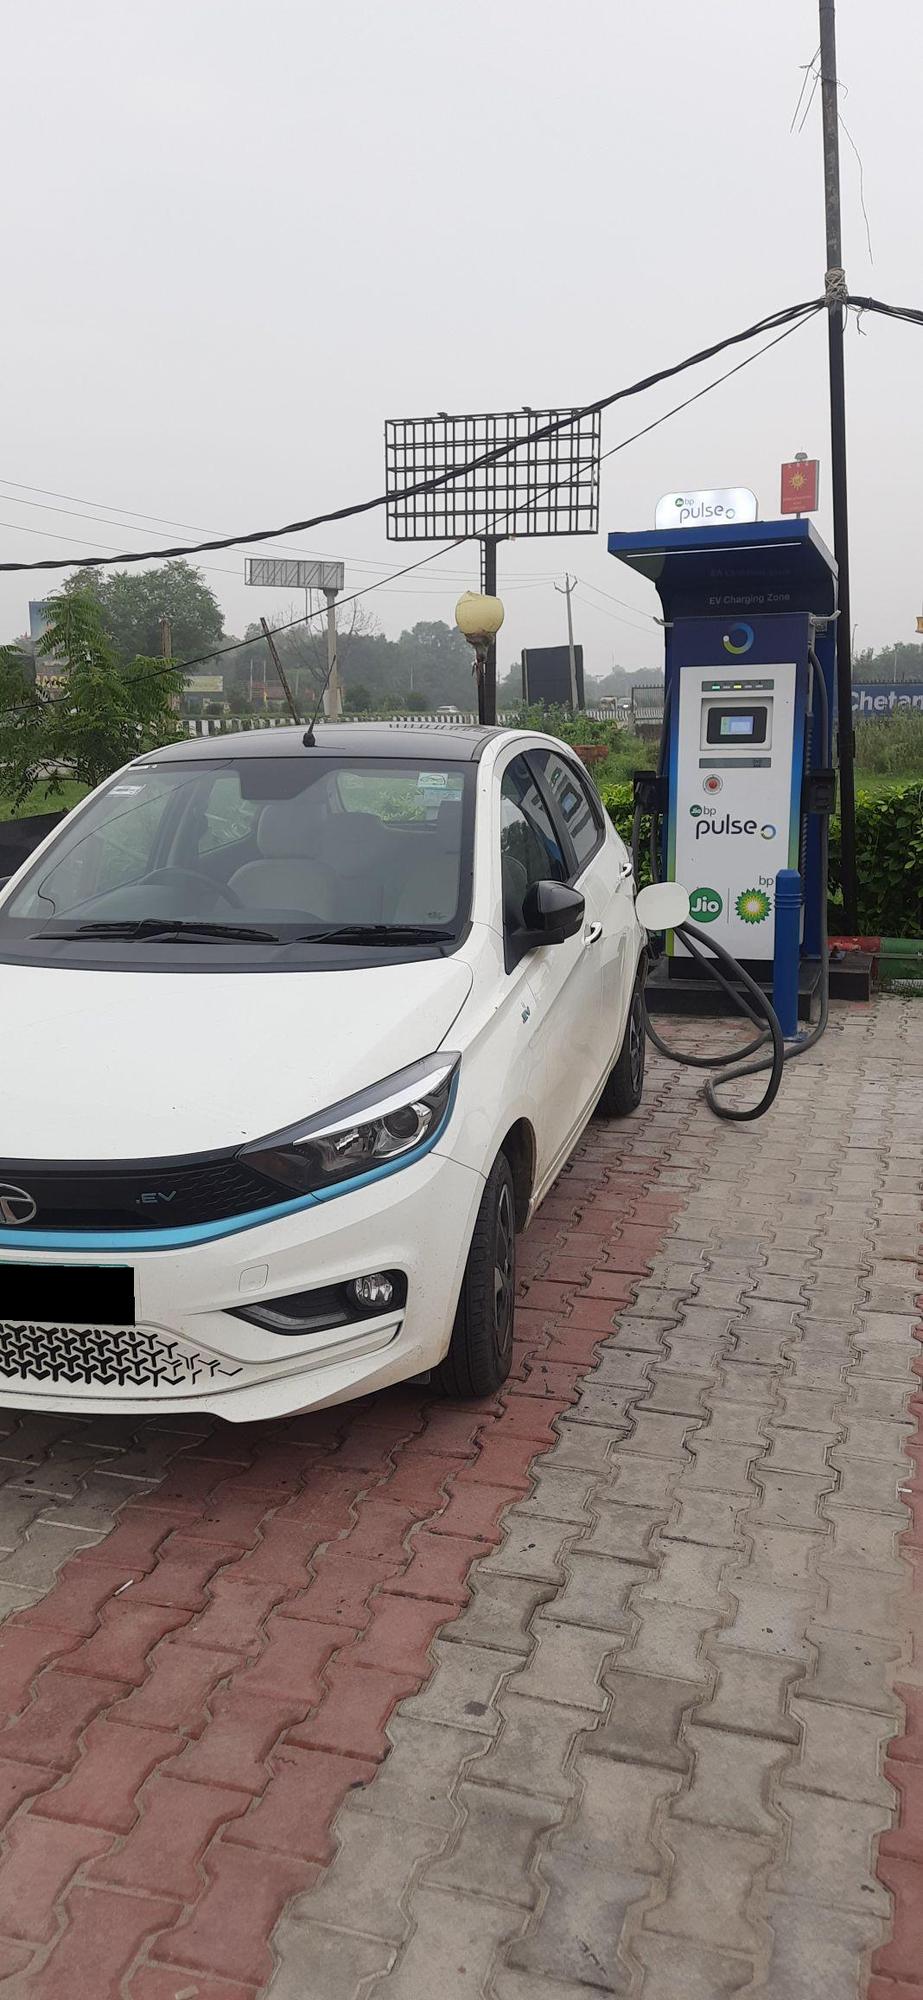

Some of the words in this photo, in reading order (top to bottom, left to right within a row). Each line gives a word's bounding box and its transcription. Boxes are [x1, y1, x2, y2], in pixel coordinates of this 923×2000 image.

[680, 502, 723, 523] pulse
[703, 806, 716, 816] bp
[695, 814, 757, 840] pulse
[759, 876, 774, 888] bp
[691, 896, 719, 912] Jio
